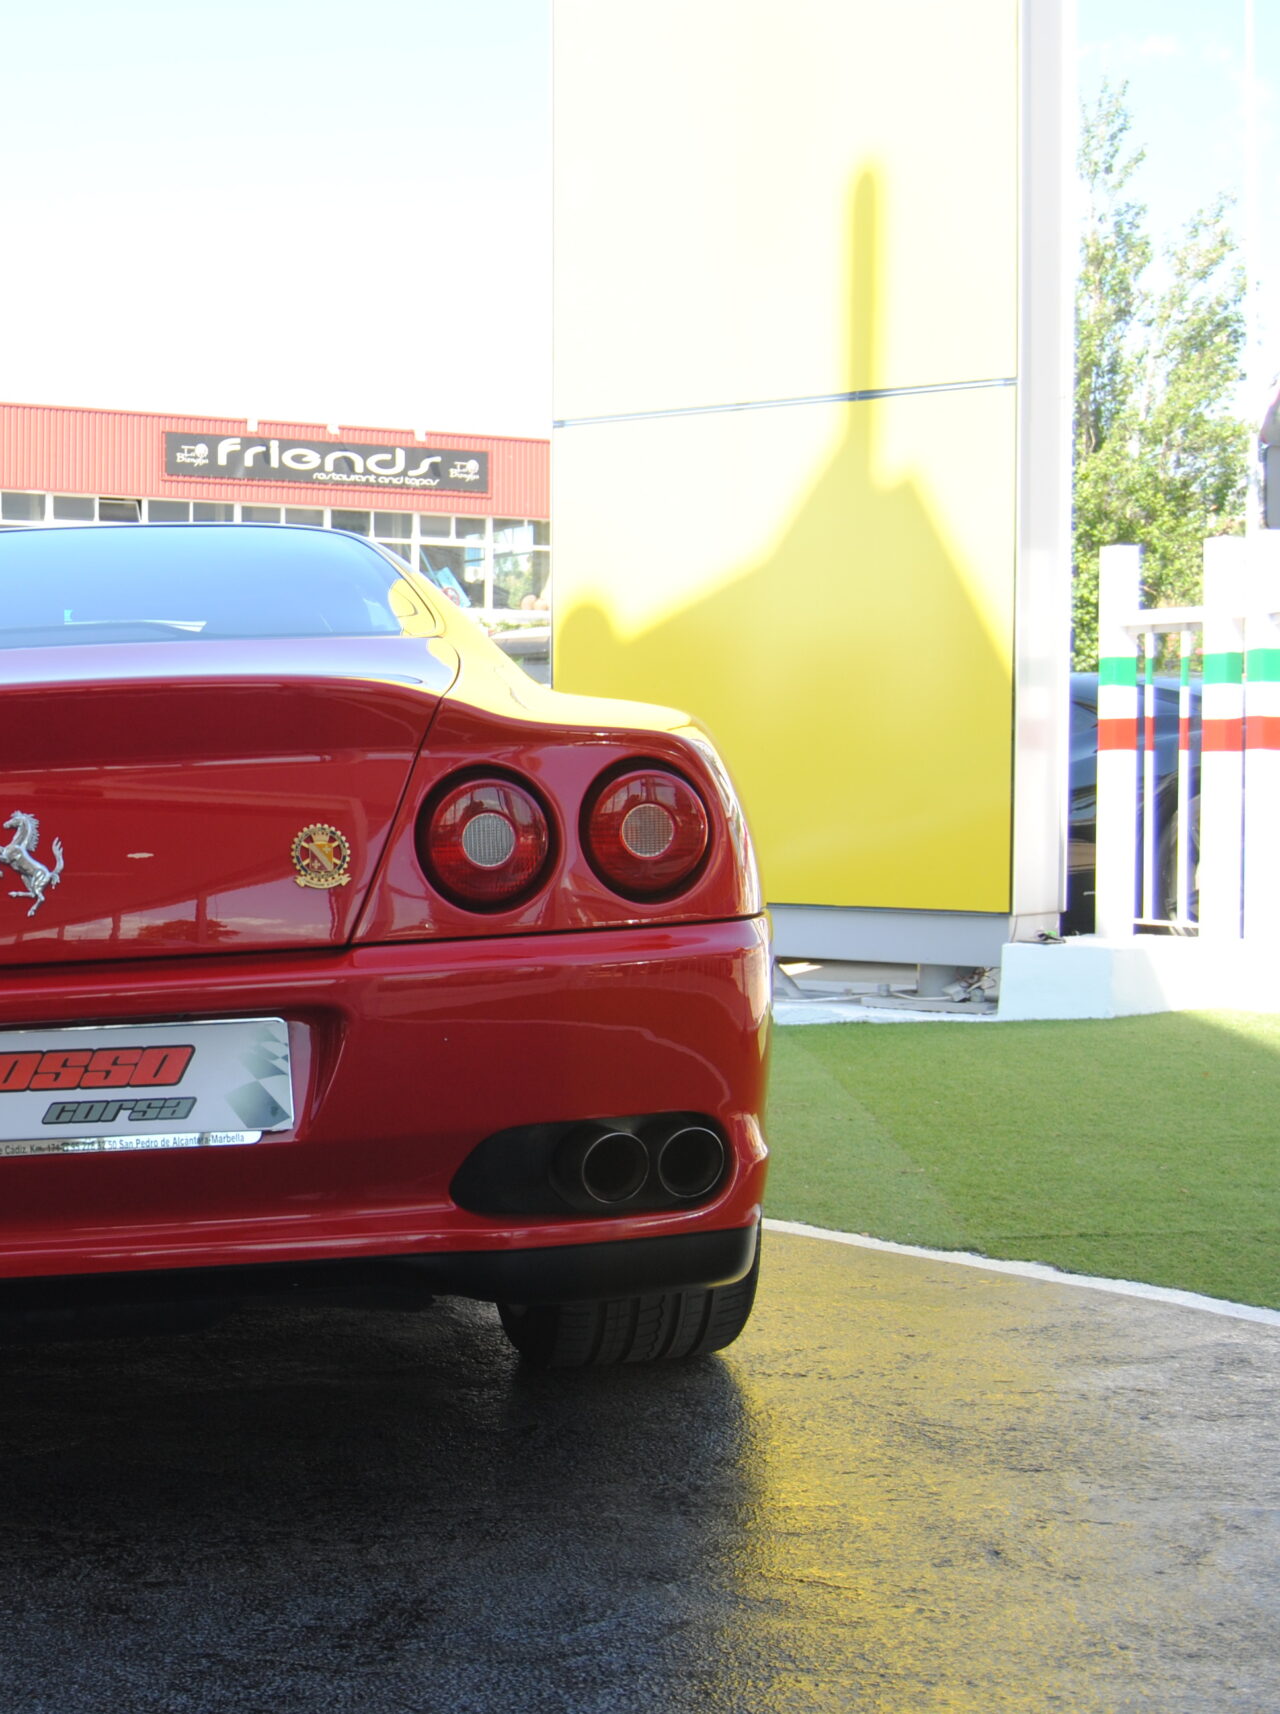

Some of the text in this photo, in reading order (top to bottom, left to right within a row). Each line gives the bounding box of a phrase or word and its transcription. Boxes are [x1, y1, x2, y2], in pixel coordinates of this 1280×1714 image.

[217, 438, 442, 477] friends
[377, 475, 403, 484] and
[404, 476, 440, 487] tapas
[40, 1096, 198, 1125] corsa
[119, 1138, 134, 1149] San
[135, 1137, 160, 1149] Pedro
[161, 1136, 171, 1148] de
